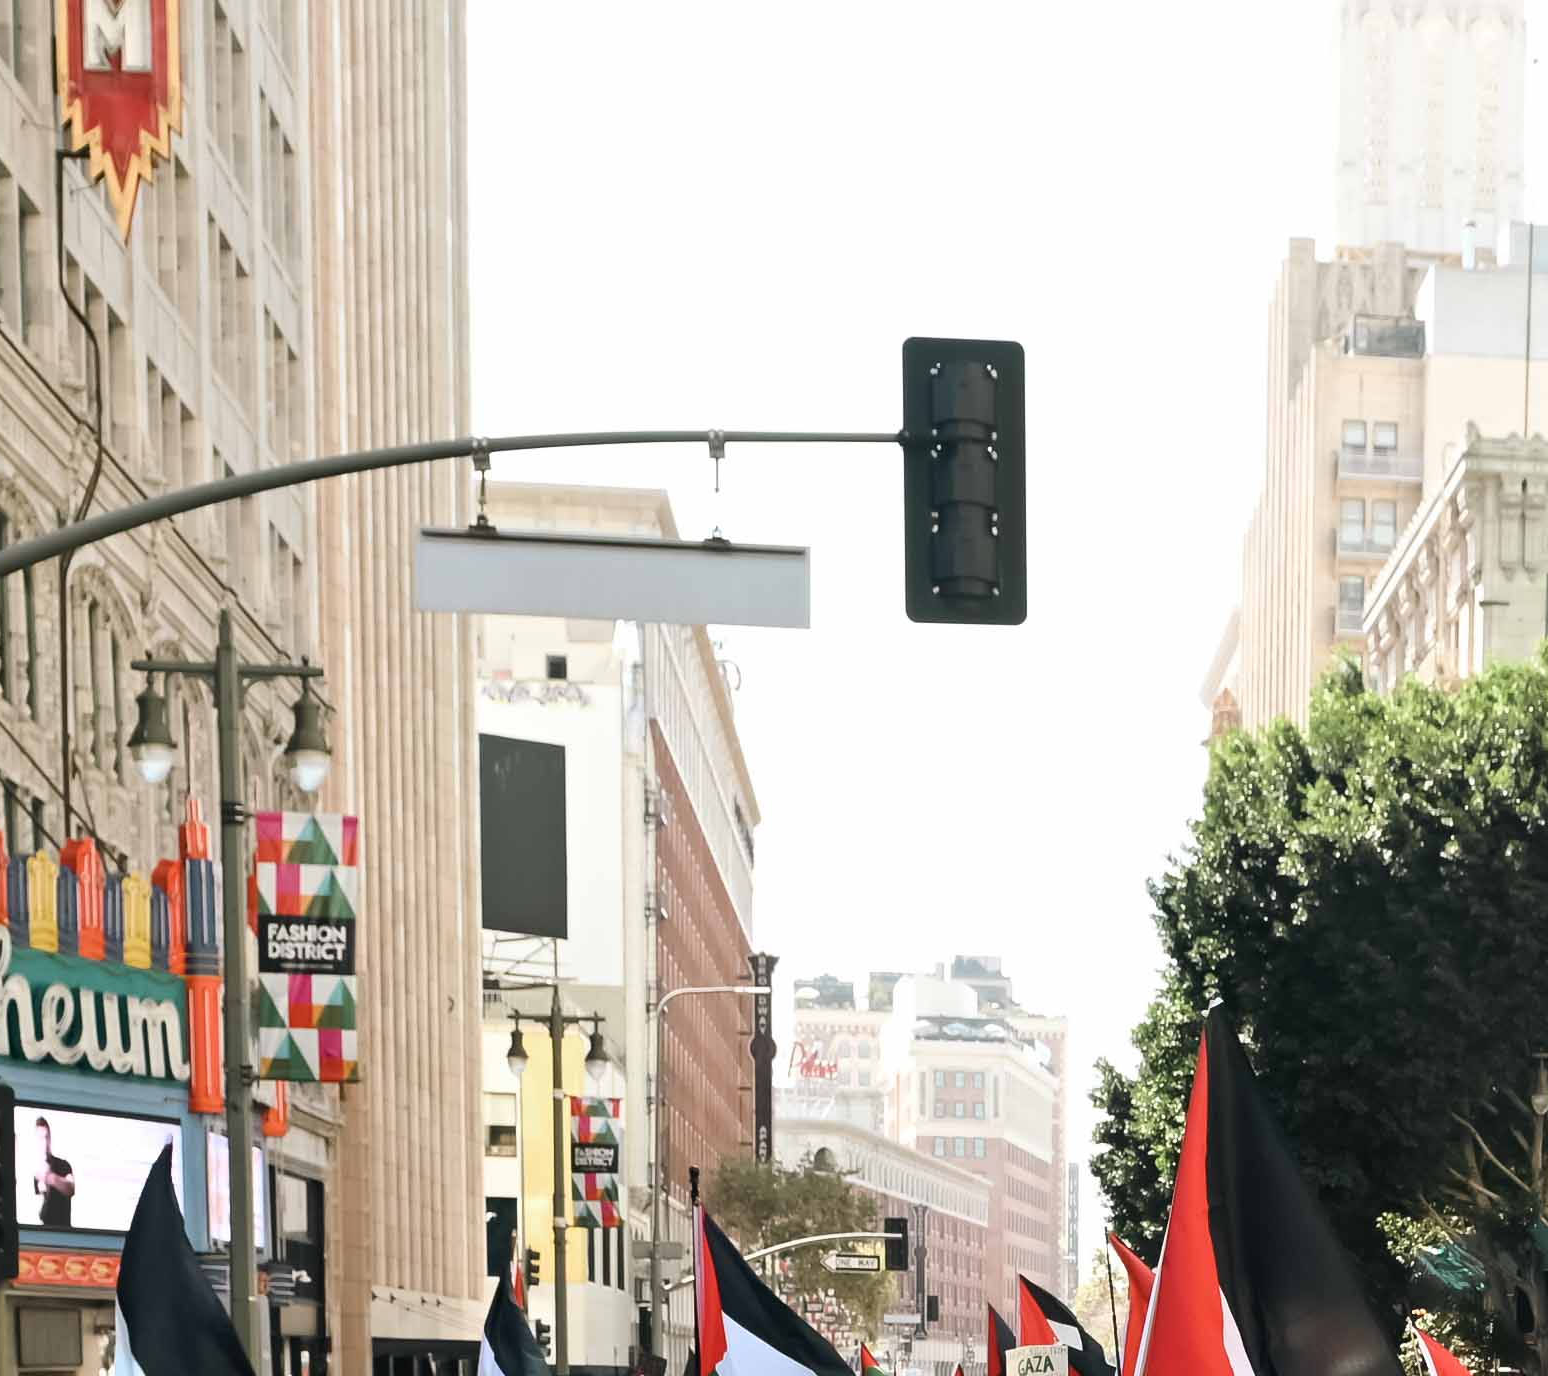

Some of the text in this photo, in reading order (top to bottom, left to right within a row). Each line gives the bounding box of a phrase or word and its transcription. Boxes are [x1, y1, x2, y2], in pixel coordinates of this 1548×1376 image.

[267, 922, 347, 943] FASHION
[267, 940, 346, 961] DISTRICT
[1018, 1355, 1054, 1376] GAZA
